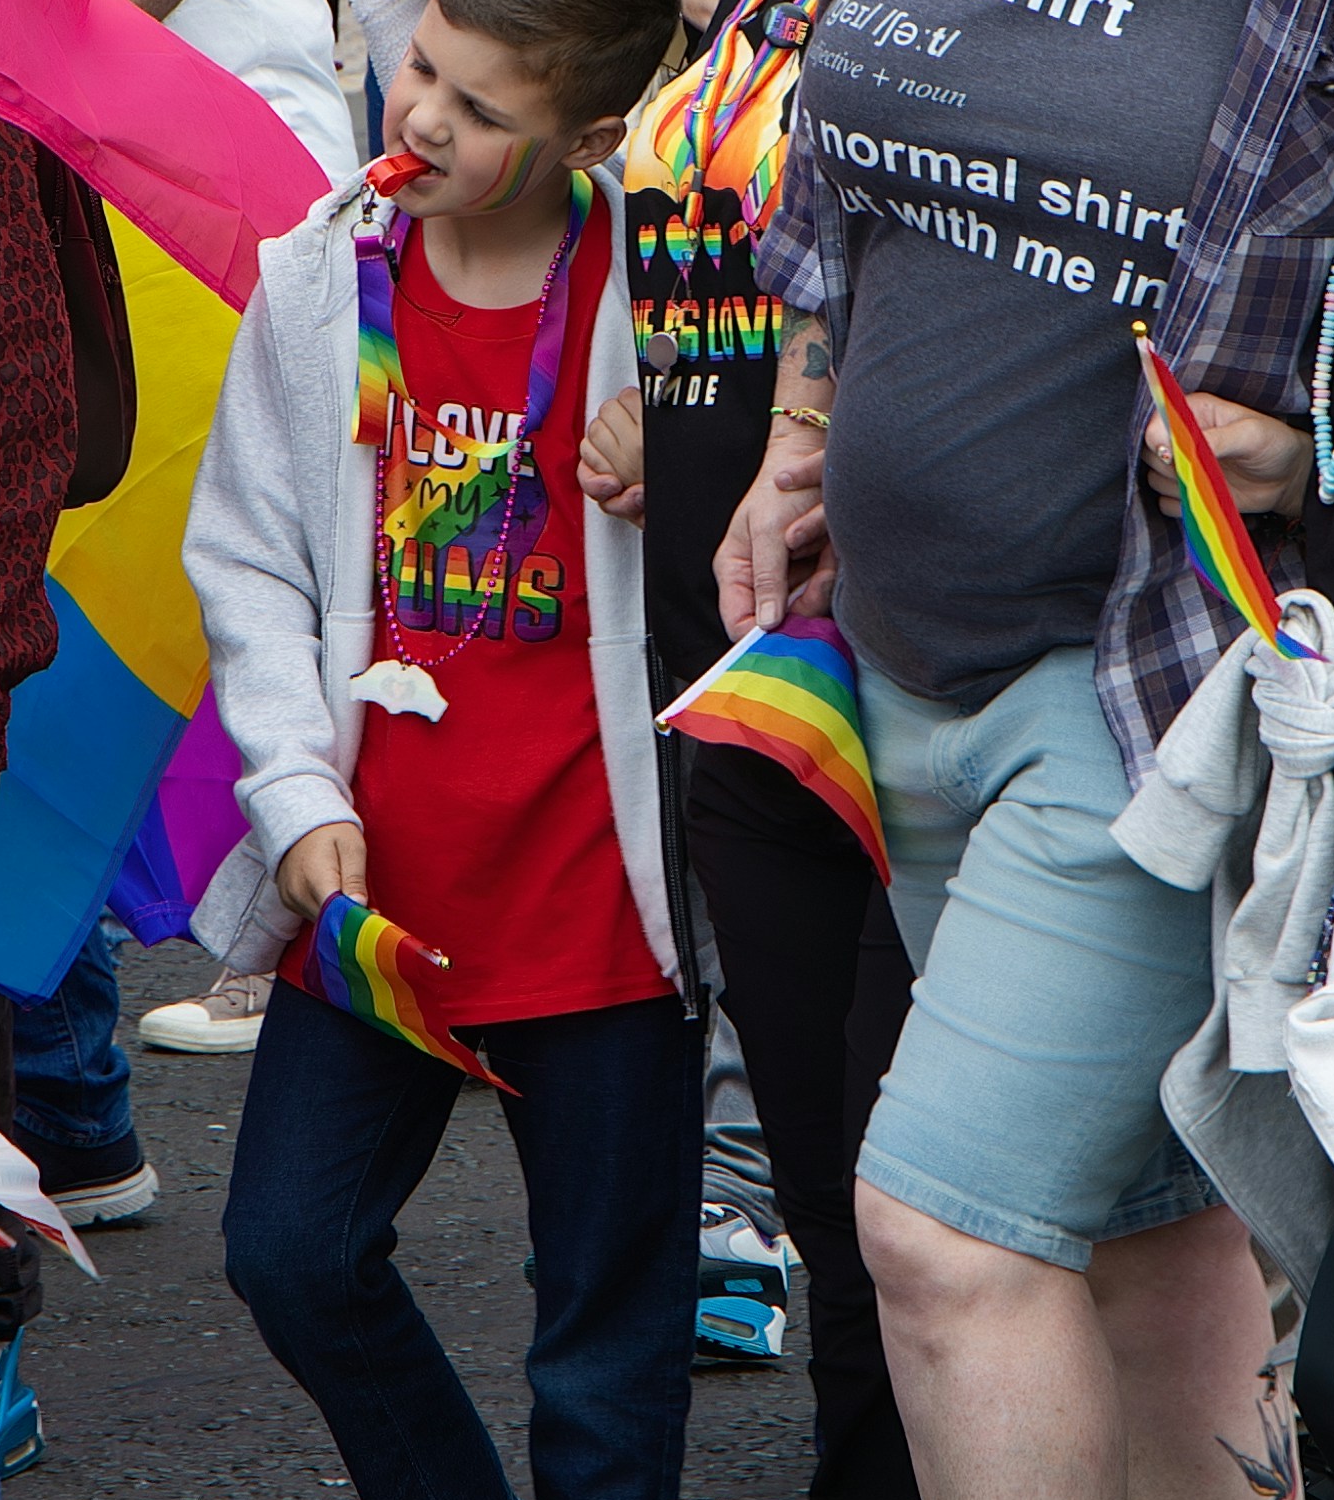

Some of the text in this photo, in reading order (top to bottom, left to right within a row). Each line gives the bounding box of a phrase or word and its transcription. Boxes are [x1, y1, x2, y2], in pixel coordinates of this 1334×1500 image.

[872, 67, 891, 88] +
[897, 77, 968, 109] noun
[819, 118, 1018, 203] normal
[1038, 178, 1188, 251] shirt
[837, 183, 886, 219] ut
[886, 197, 998, 261] with
[1012, 235, 1096, 293] me
[632, 299, 655, 364] VE
[403, 398, 535, 478] LOVE
[420, 477, 481, 537] my
